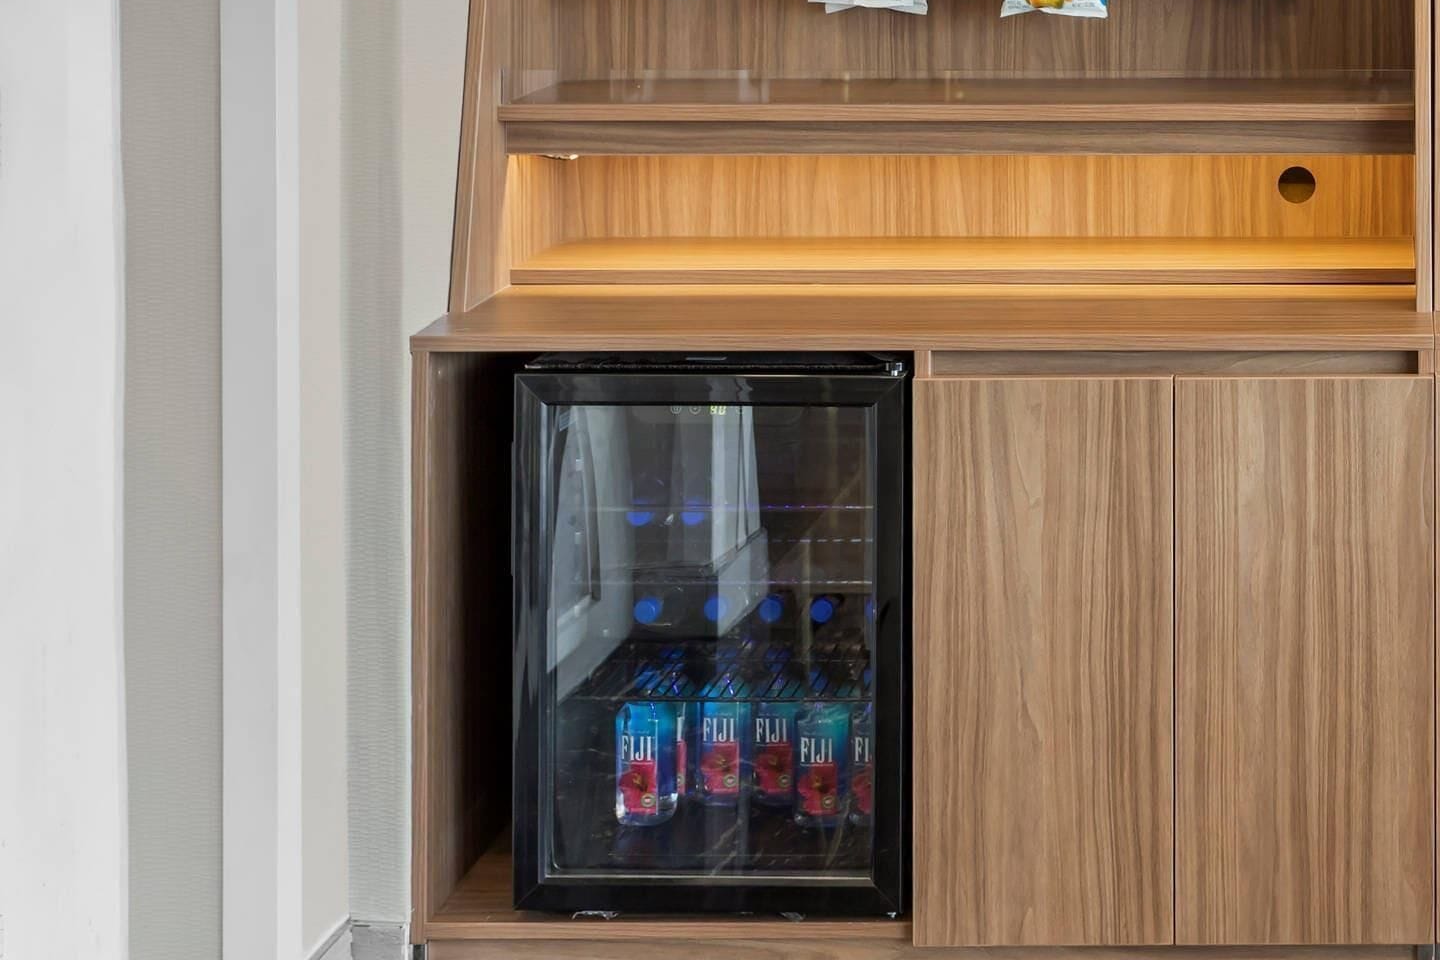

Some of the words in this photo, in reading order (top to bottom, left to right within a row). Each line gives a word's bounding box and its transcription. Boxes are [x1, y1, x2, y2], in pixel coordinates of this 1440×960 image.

[703, 717, 735, 742] FIJI
[755, 717, 787, 743] FIJI
[621, 735, 653, 761] FIJI
[800, 737, 833, 764] FIJI
[855, 737, 872, 762] FI
